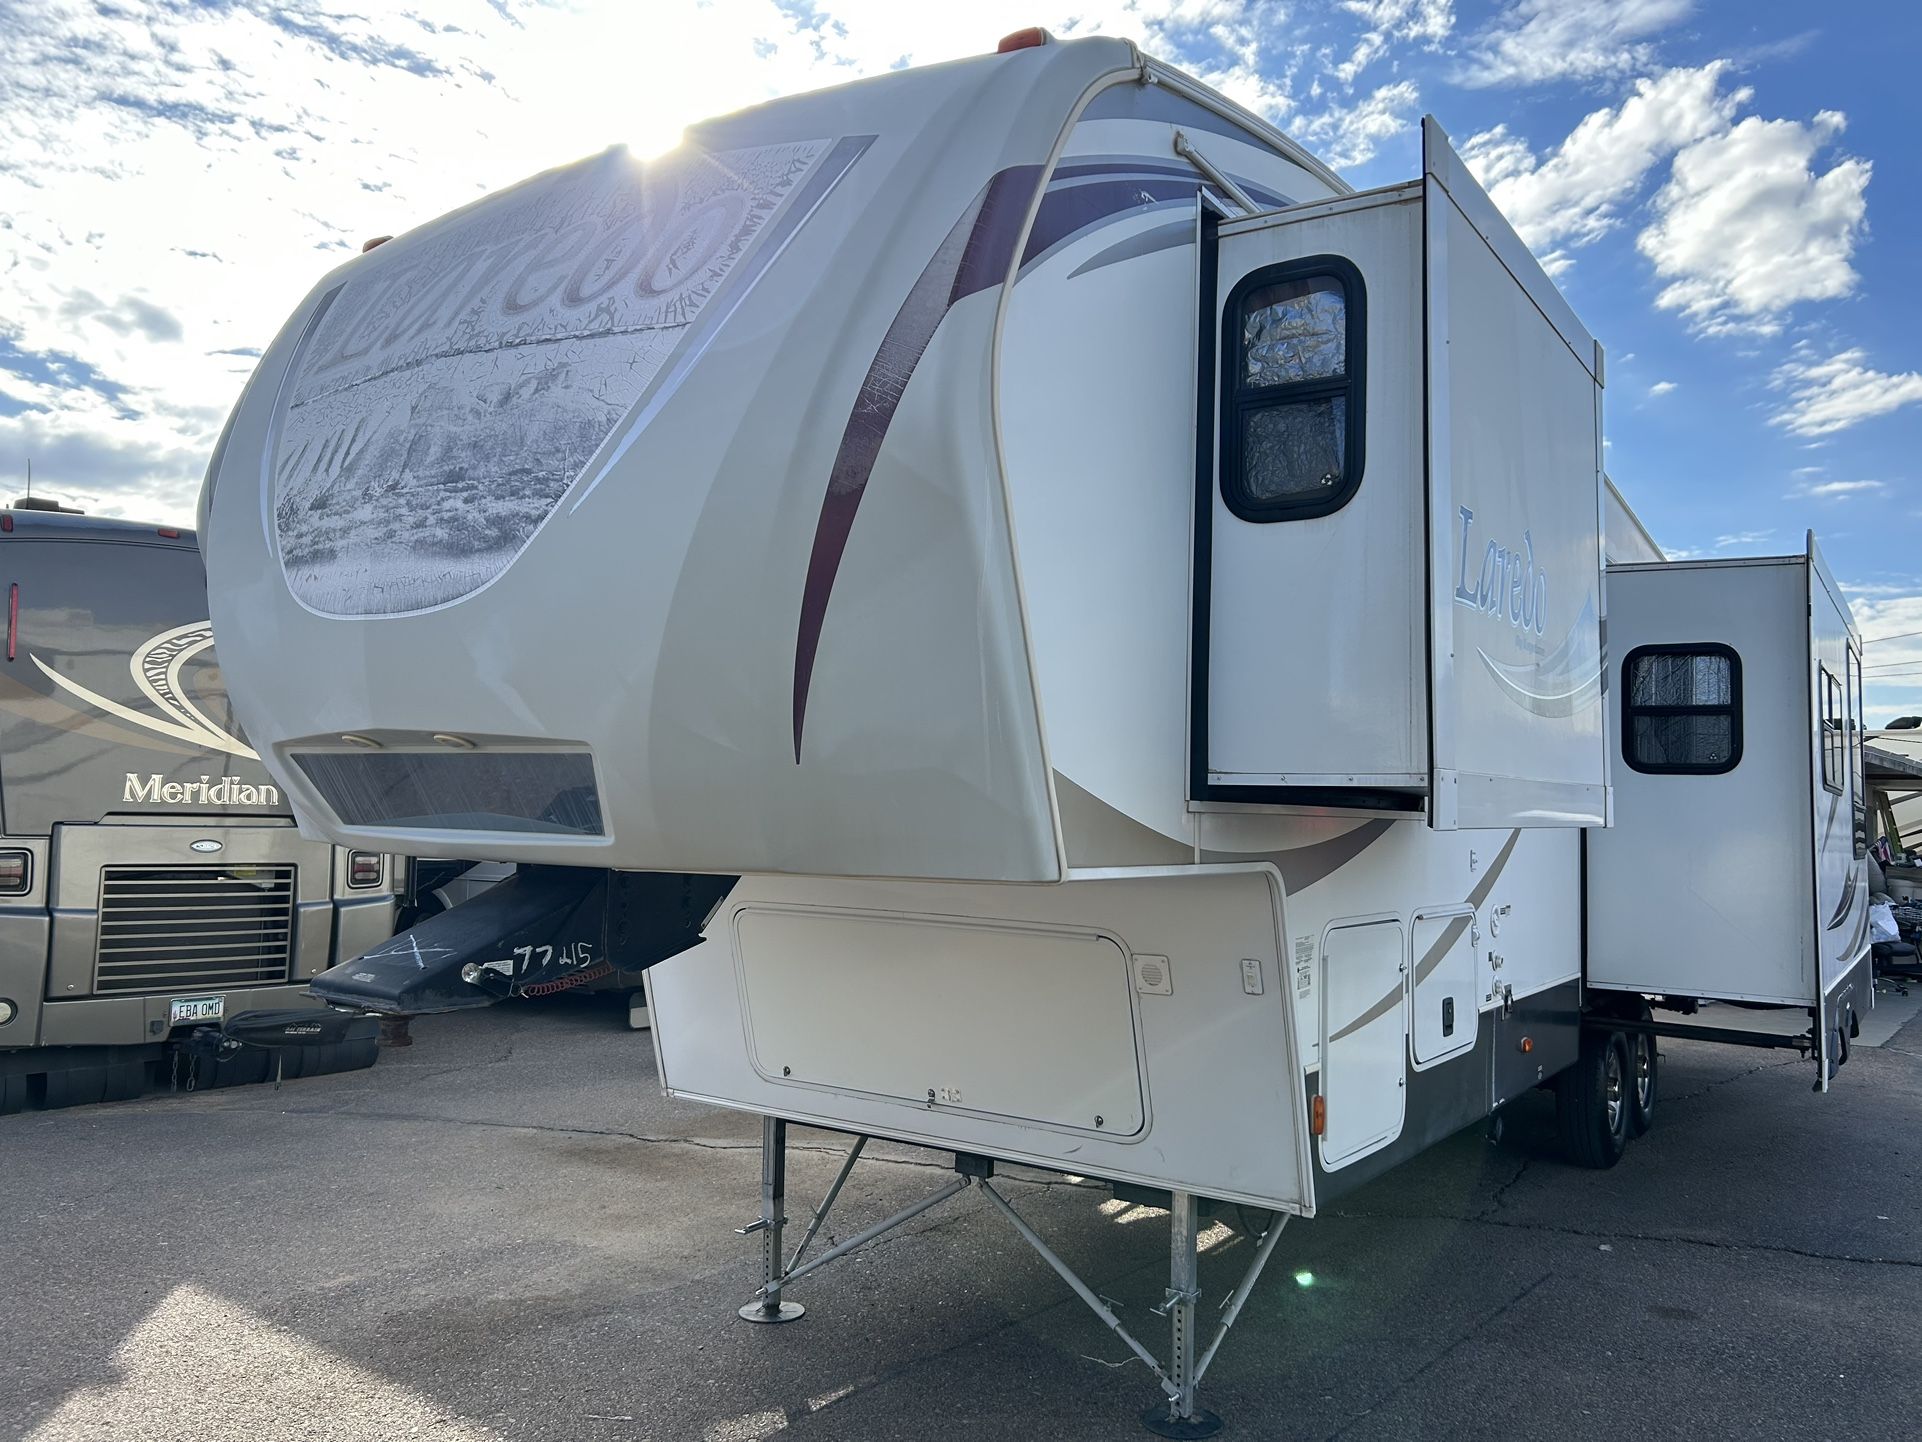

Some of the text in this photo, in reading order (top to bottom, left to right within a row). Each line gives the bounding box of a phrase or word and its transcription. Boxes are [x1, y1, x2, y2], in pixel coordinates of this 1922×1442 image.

[1454, 504, 1546, 637] Laredo
[122, 772, 279, 806] Meridian
[178, 1004, 198, 1018] EBA
